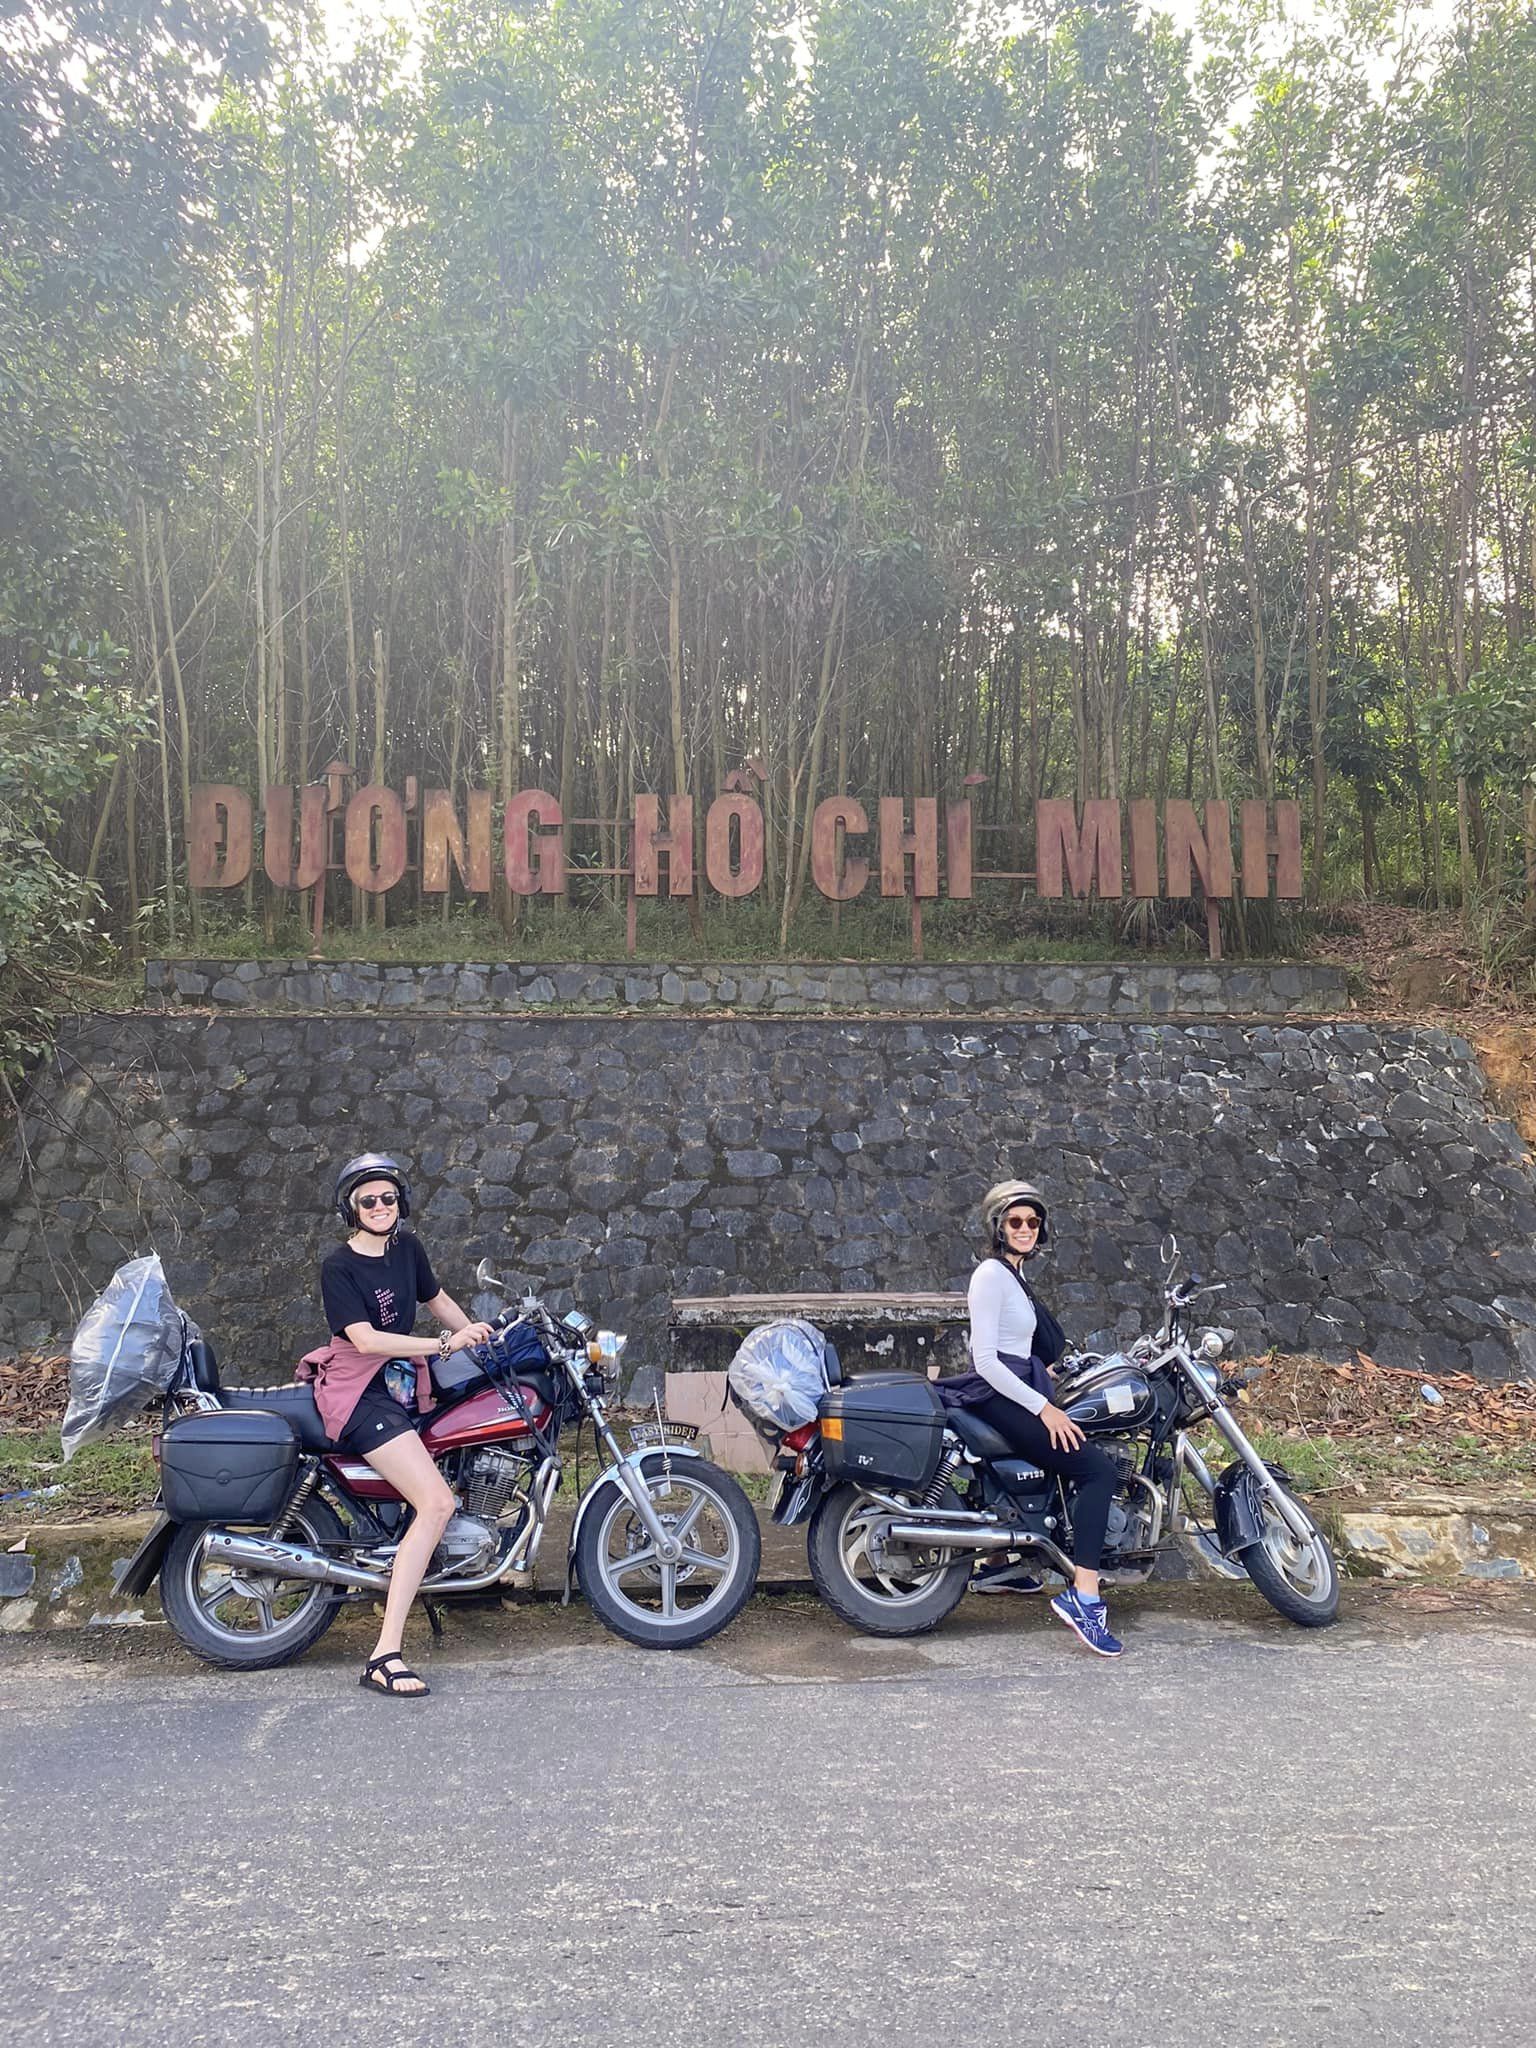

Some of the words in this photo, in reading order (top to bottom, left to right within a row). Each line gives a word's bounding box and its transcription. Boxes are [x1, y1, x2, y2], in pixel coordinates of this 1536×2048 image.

[634, 757, 769, 897] HỒ
[811, 771, 991, 901] CHÍ
[1035, 799, 1302, 900] MINH
[633, 1424, 661, 1440] EASY
[663, 1424, 696, 1439] RIDER
